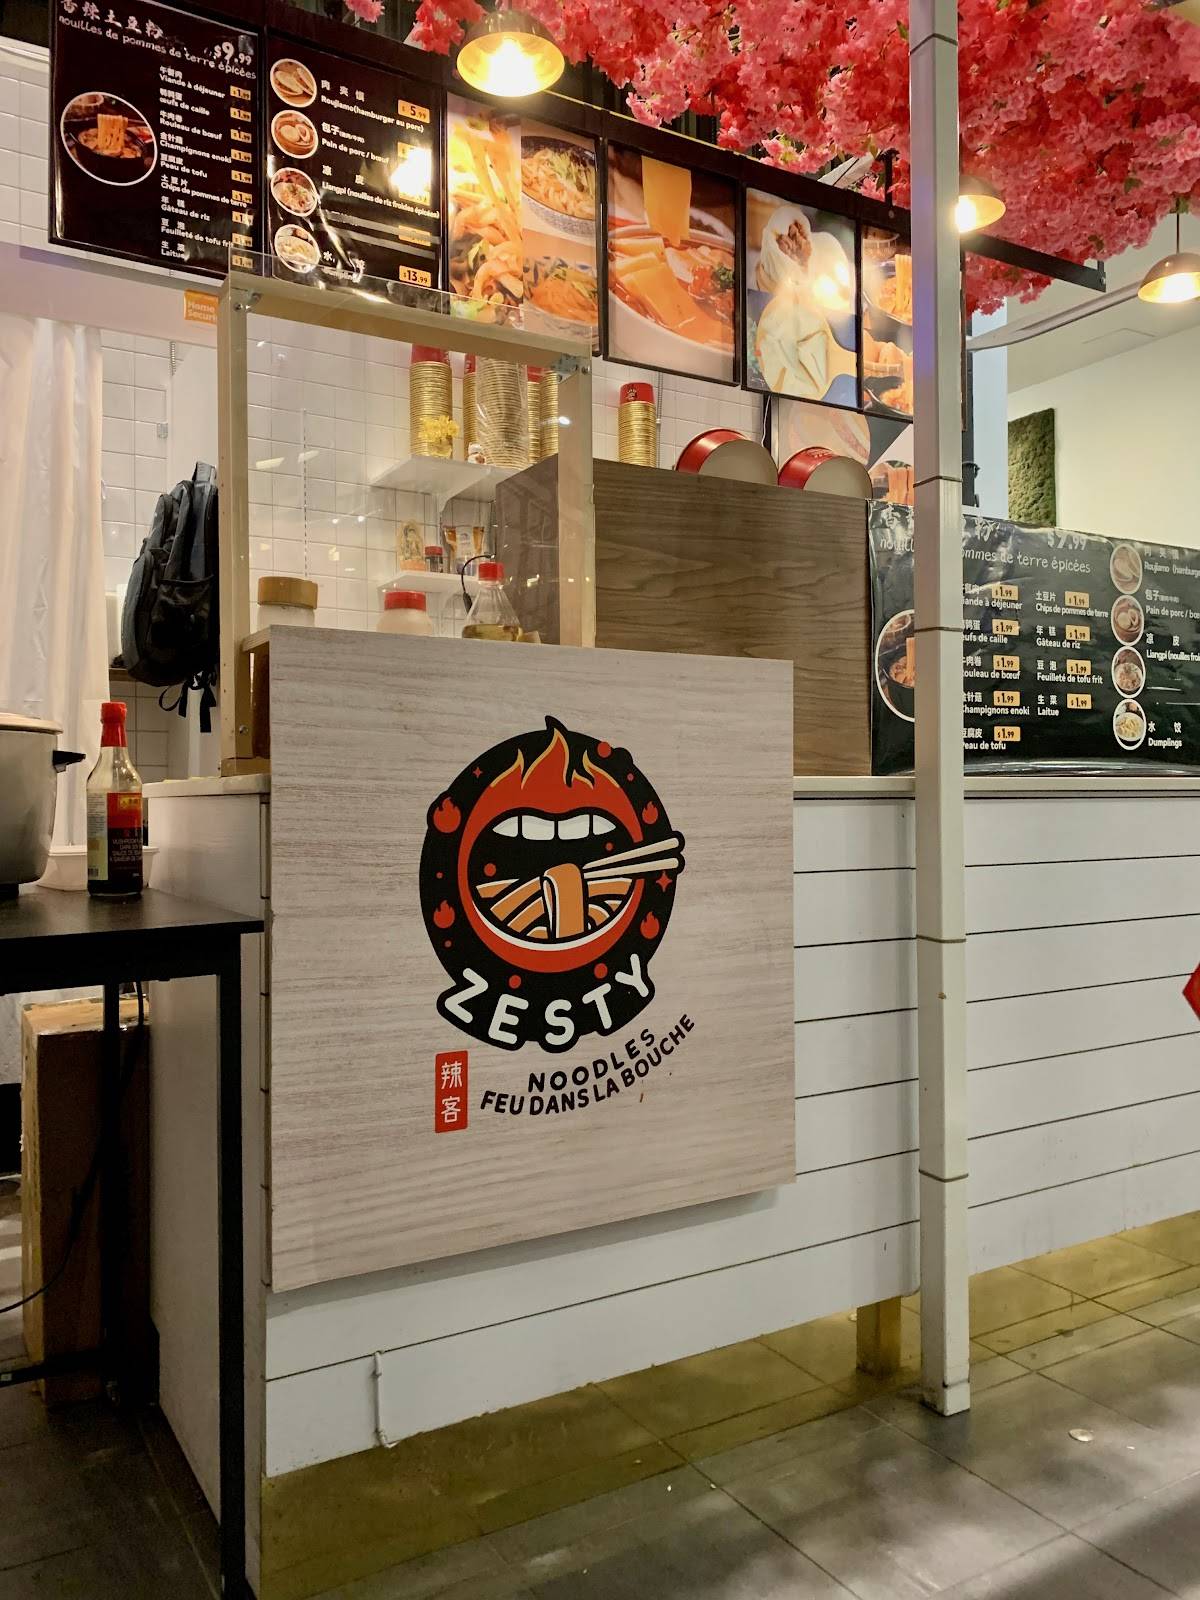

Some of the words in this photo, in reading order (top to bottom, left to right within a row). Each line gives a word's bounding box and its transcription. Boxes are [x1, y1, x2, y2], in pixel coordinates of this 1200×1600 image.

[59, 15, 102, 35] nouilles
[105, 28, 119, 40] de
[123, 35, 166, 54] pommes
[169, 47, 182, 58] de
[184, 50, 216, 69] terre
[214, 41, 251, 66] $9.99
[159, 74, 186, 87] Viande
[193, 84, 226, 98] déjeuner
[160, 117, 190, 132] Rouleau
[396, 119, 406, 127] au
[160, 140, 210, 159] Champignons
[321, 138, 338, 149] Pain
[338, 144, 348, 153] de
[349, 148, 365, 158] porc
[161, 161, 179, 171] Peau
[191, 169, 207, 179] tofu
[161, 182, 181, 193] Chips
[191, 190, 220, 203] pommes
[200, 213, 210, 222] riz
[205, 236, 221, 247] tofu
[1016, 552, 1048, 568] terre
[1051, 556, 1091, 573] épicées
[1035, 591, 1057, 604] 土豆片
[991, 599, 1023, 610] déjeuner
[1036, 603, 1052, 614] Chips
[1053, 605, 1061, 613] de
[1061, 607, 1086, 617] pommes
[1086, 608, 1095, 617] de
[1095, 609, 1109, 618] terre
[1146, 605, 1160, 615] Pain
[1161, 606, 1169, 616] de
[1170, 609, 1184, 619] porc
[995, 622, 1013, 633] $1.99
[979, 635, 989, 643] de
[989, 636, 1009, 645] caille
[1037, 637, 1061, 649] Gâteau
[1062, 639, 1071, 648] de
[1071, 640, 1081, 649] riz
[1146, 649, 1167, 662] Liangpi
[996, 658, 1014, 669] $1.99
[1070, 664, 1087, 675] $1.99
[962, 669, 989, 679] ouleau
[990, 670, 1000, 679] de
[1037, 672, 1066, 682] Feuilleté
[1066, 674, 1076, 683] de
[1077, 675, 1091, 684] tofu
[1092, 675, 1104, 685] frit
[997, 692, 1014, 704] $1.99
[1070, 697, 1087, 707] $1.99
[1010, 706, 1030, 716] enoki
[1037, 706, 1060, 717] Laitue
[997, 728, 1015, 739] $1.99
[979, 741, 990, 750] de
[990, 741, 1007, 751] tofu
[1148, 737, 1183, 750] Dumplings
[445, 953, 650, 1047] ZESTY
[480, 1090, 524, 1116] FEU
[529, 1088, 590, 1116] DANS
[593, 1077, 620, 1103] LA
[620, 1013, 696, 1089] BOUCHE
[528, 1028, 656, 1093] NOODLES
[440, 1060, 463, 1125] 辣客
